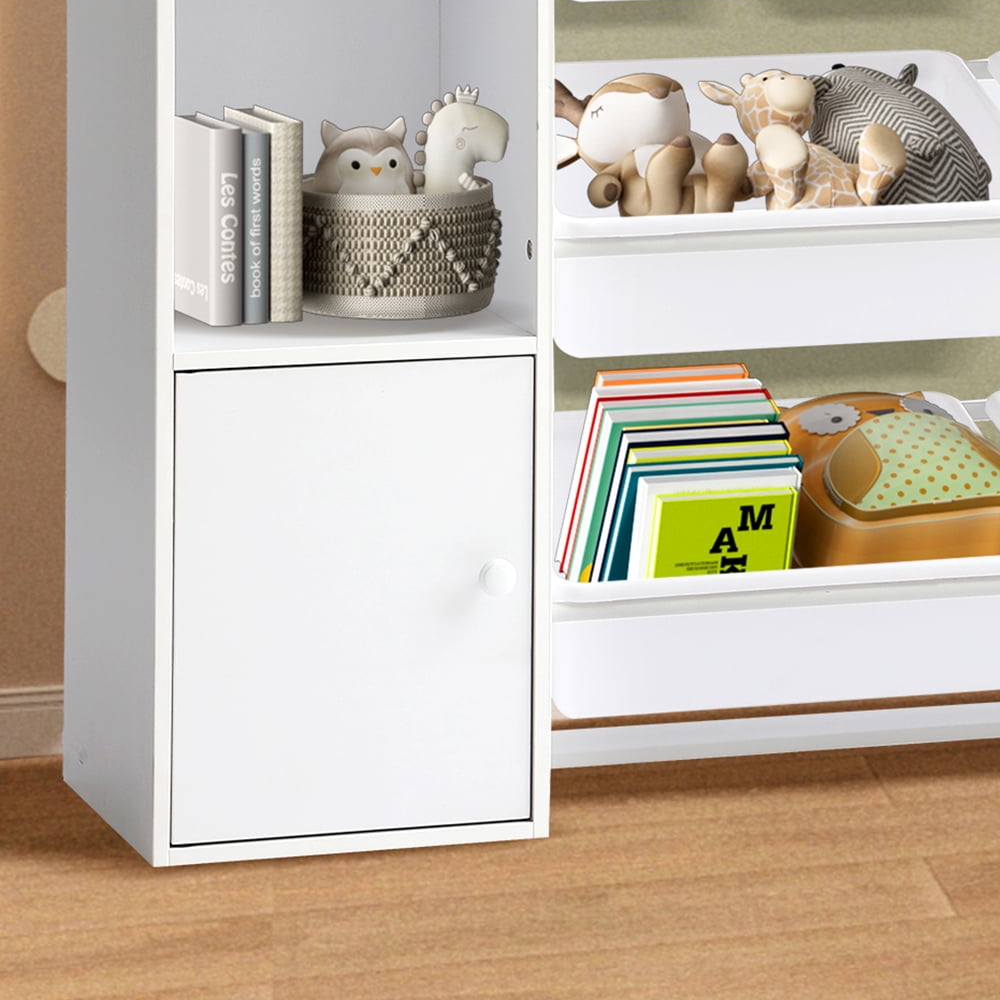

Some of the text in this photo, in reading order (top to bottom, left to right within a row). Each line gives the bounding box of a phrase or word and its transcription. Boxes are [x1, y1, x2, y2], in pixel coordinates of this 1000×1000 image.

[220, 172, 239, 285] Les Contes
[249, 157, 262, 298] book of first words
